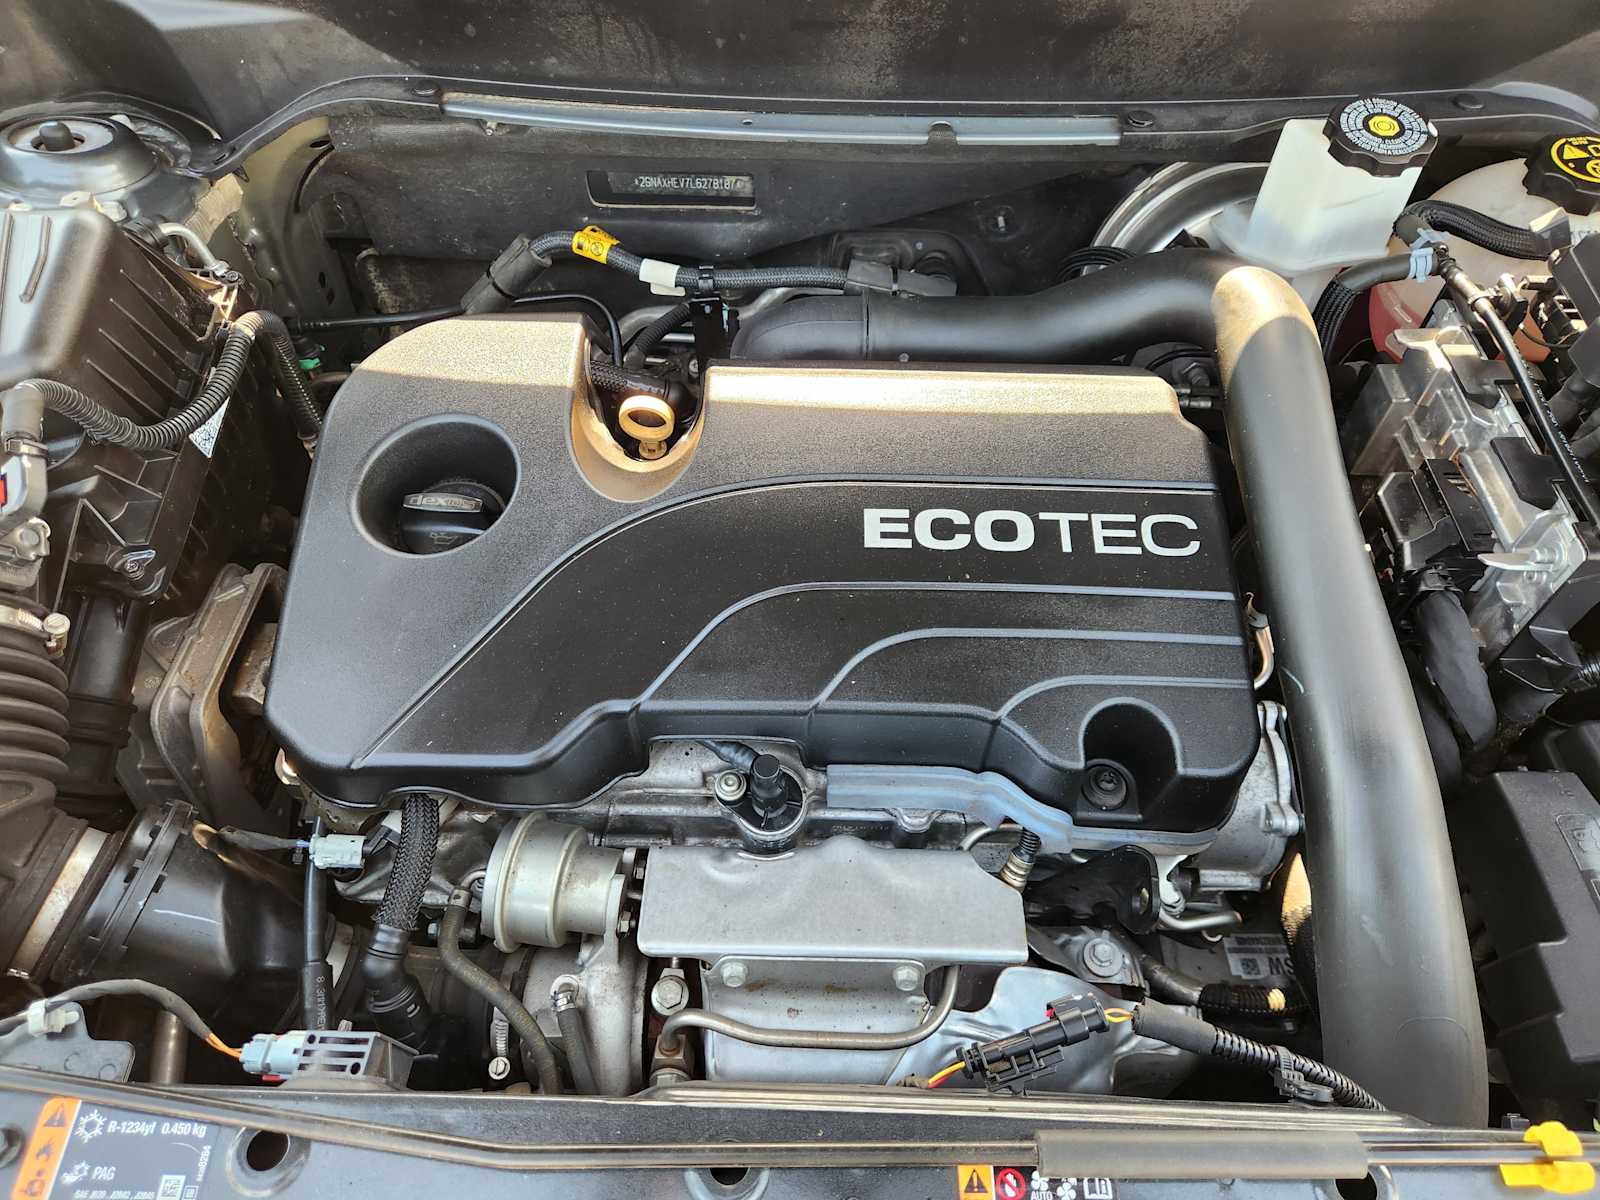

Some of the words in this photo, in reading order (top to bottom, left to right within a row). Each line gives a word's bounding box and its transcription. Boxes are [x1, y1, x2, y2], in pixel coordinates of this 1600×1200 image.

[864, 508, 1200, 556] ECOTEC
[107, 1120, 157, 1136] R-1234yf
[161, 1122, 191, 1135] 0.450
[191, 1122, 207, 1138] kg
[92, 1166, 116, 1180] PAG
[1031, 1190, 1053, 1200] AUTO
